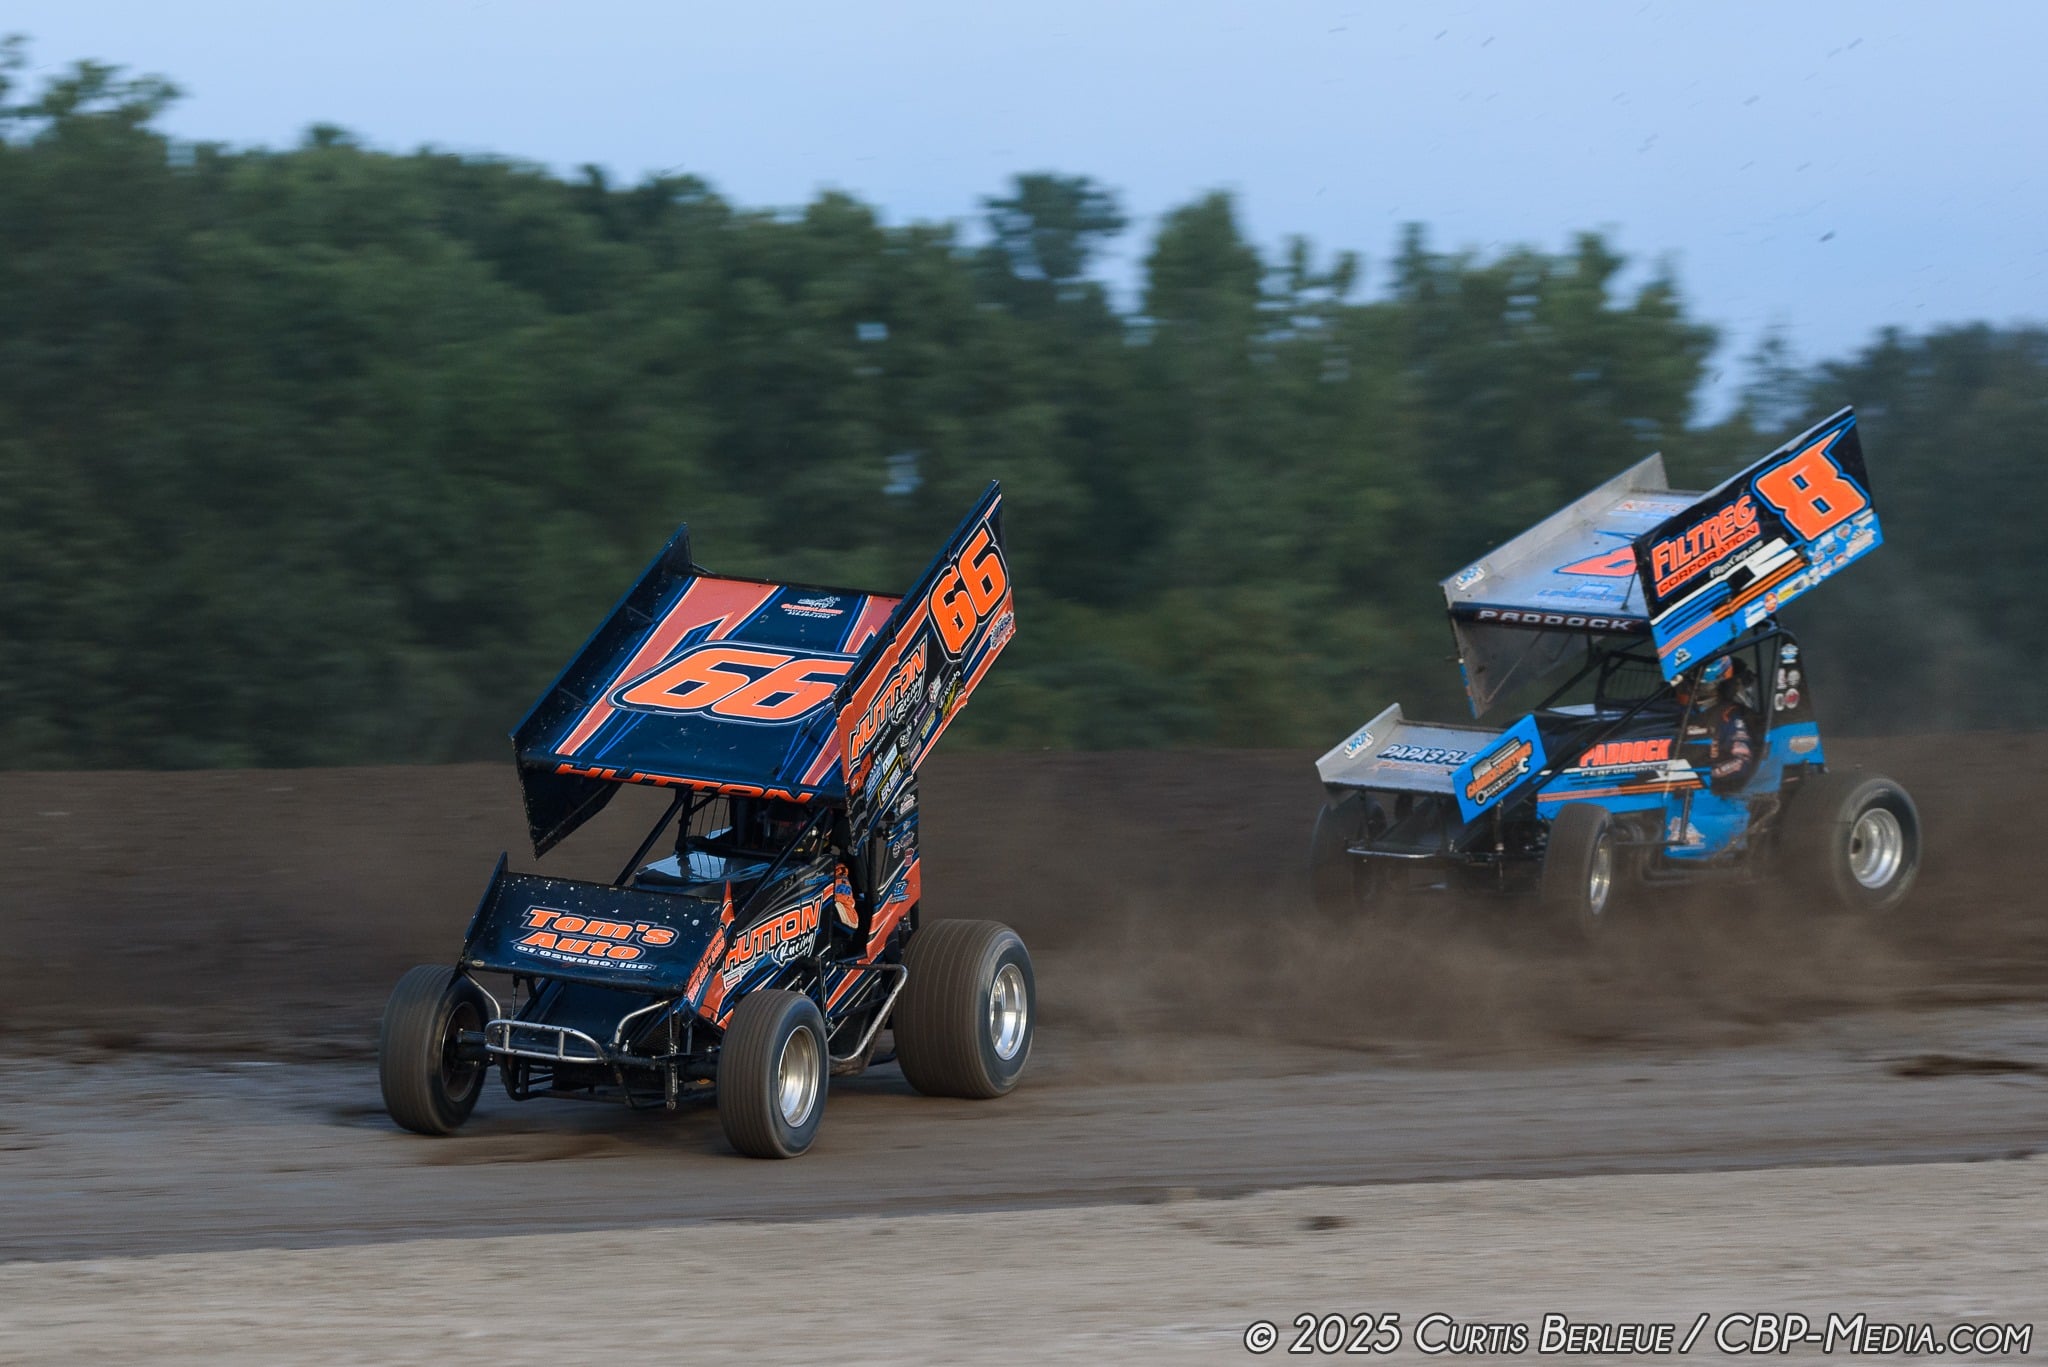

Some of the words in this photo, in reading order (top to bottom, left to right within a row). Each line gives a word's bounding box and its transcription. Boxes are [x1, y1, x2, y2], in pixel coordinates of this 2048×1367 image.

[1756, 430, 1867, 541] 8
[1651, 495, 1757, 581] FILTREC
[1659, 524, 1758, 594] CORPORATION
[930, 526, 1009, 657] 66
[1478, 609, 1633, 631] PADDOCK
[622, 647, 855, 721] 66
[851, 642, 926, 761] HUTTON
[554, 763, 815, 804] HUTTON
[1579, 738, 1673, 768] PADDOCK
[520, 931, 641, 960] Auto
[528, 909, 675, 945] Tom's
[725, 902, 820, 971] HUTTON
[775, 932, 815, 962] Racing
